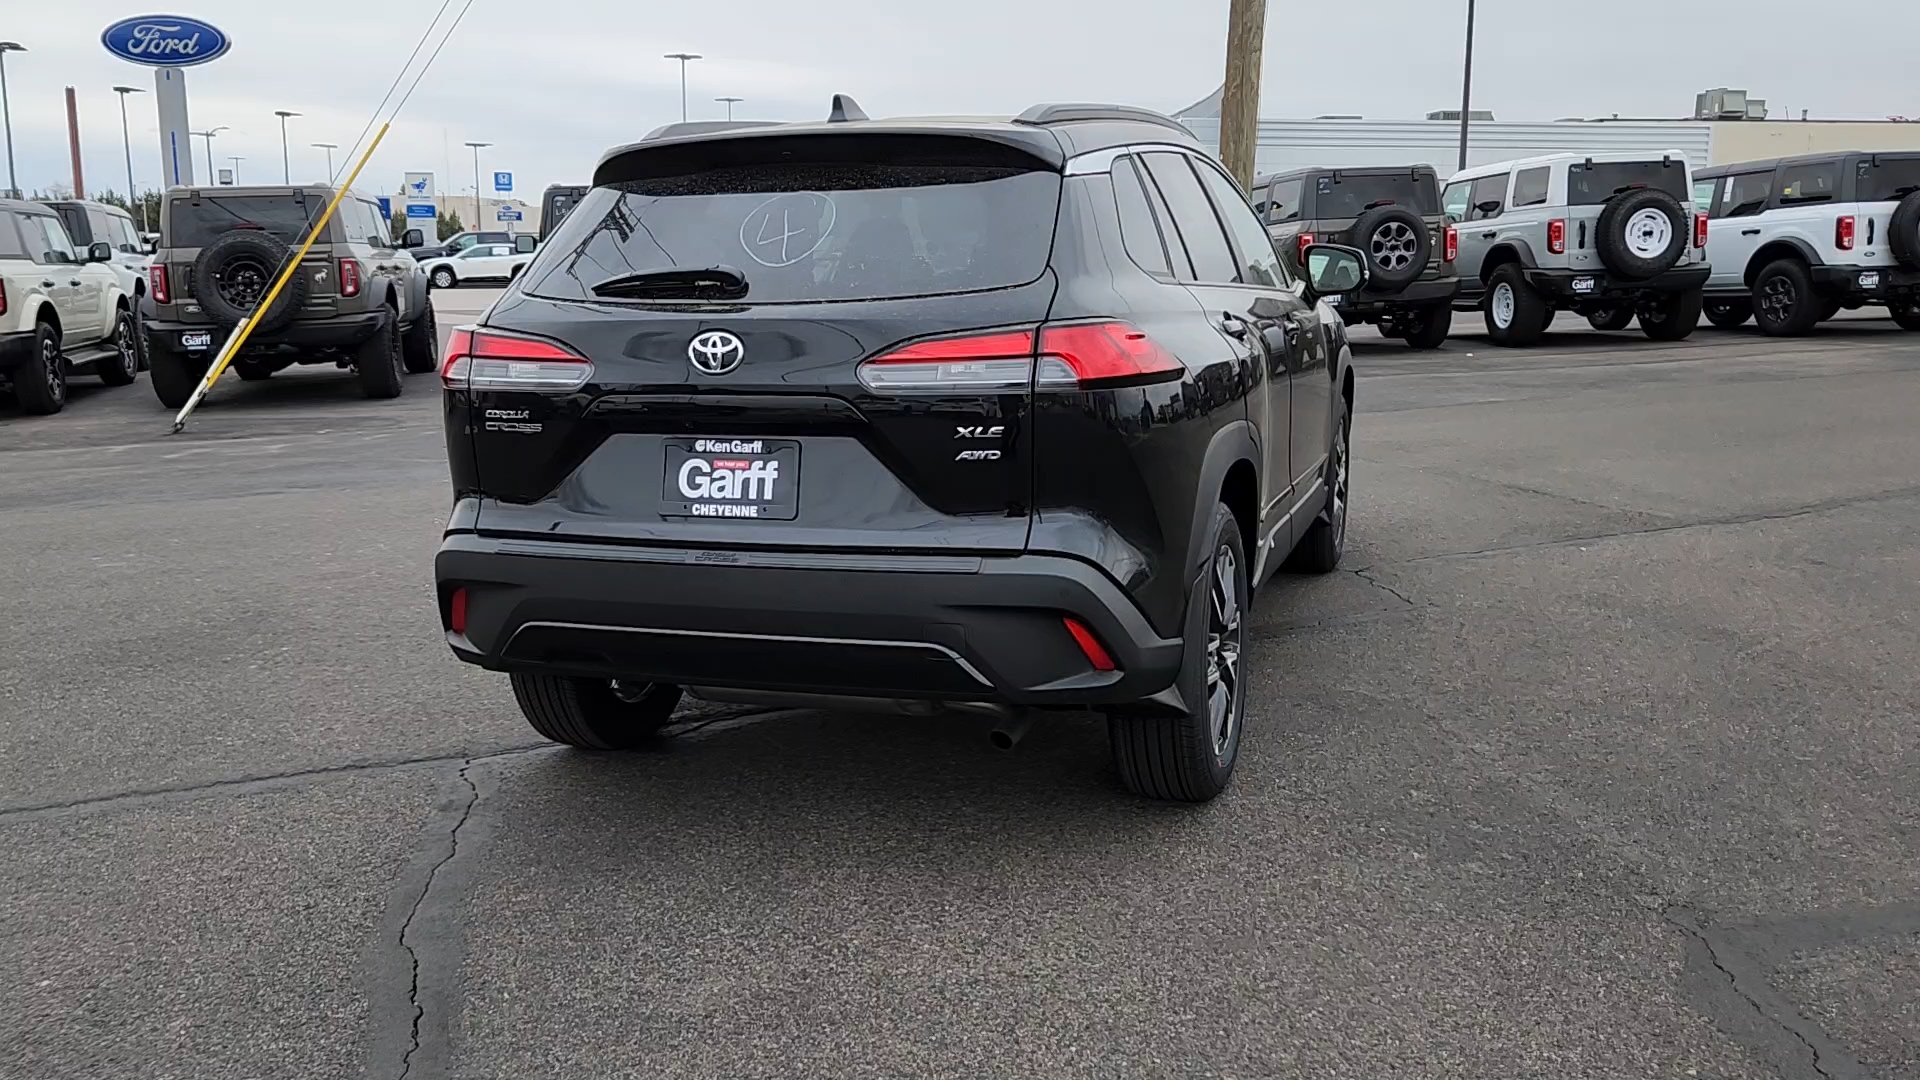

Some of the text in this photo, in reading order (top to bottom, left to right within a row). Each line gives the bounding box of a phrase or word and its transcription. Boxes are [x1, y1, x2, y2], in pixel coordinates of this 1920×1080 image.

[127, 24, 200, 54] Ford
[757, 209, 806, 262] 4
[181, 334, 211, 346] Garff
[485, 409, 530, 419] COROLLA
[485, 421, 543, 432] CROSS
[953, 426, 1005, 439] XLE
[705, 439, 763, 454] Ken Garff
[954, 450, 1001, 461] AWD
[678, 458, 778, 500] Garff
[691, 503, 758, 517] CHEYENNE
